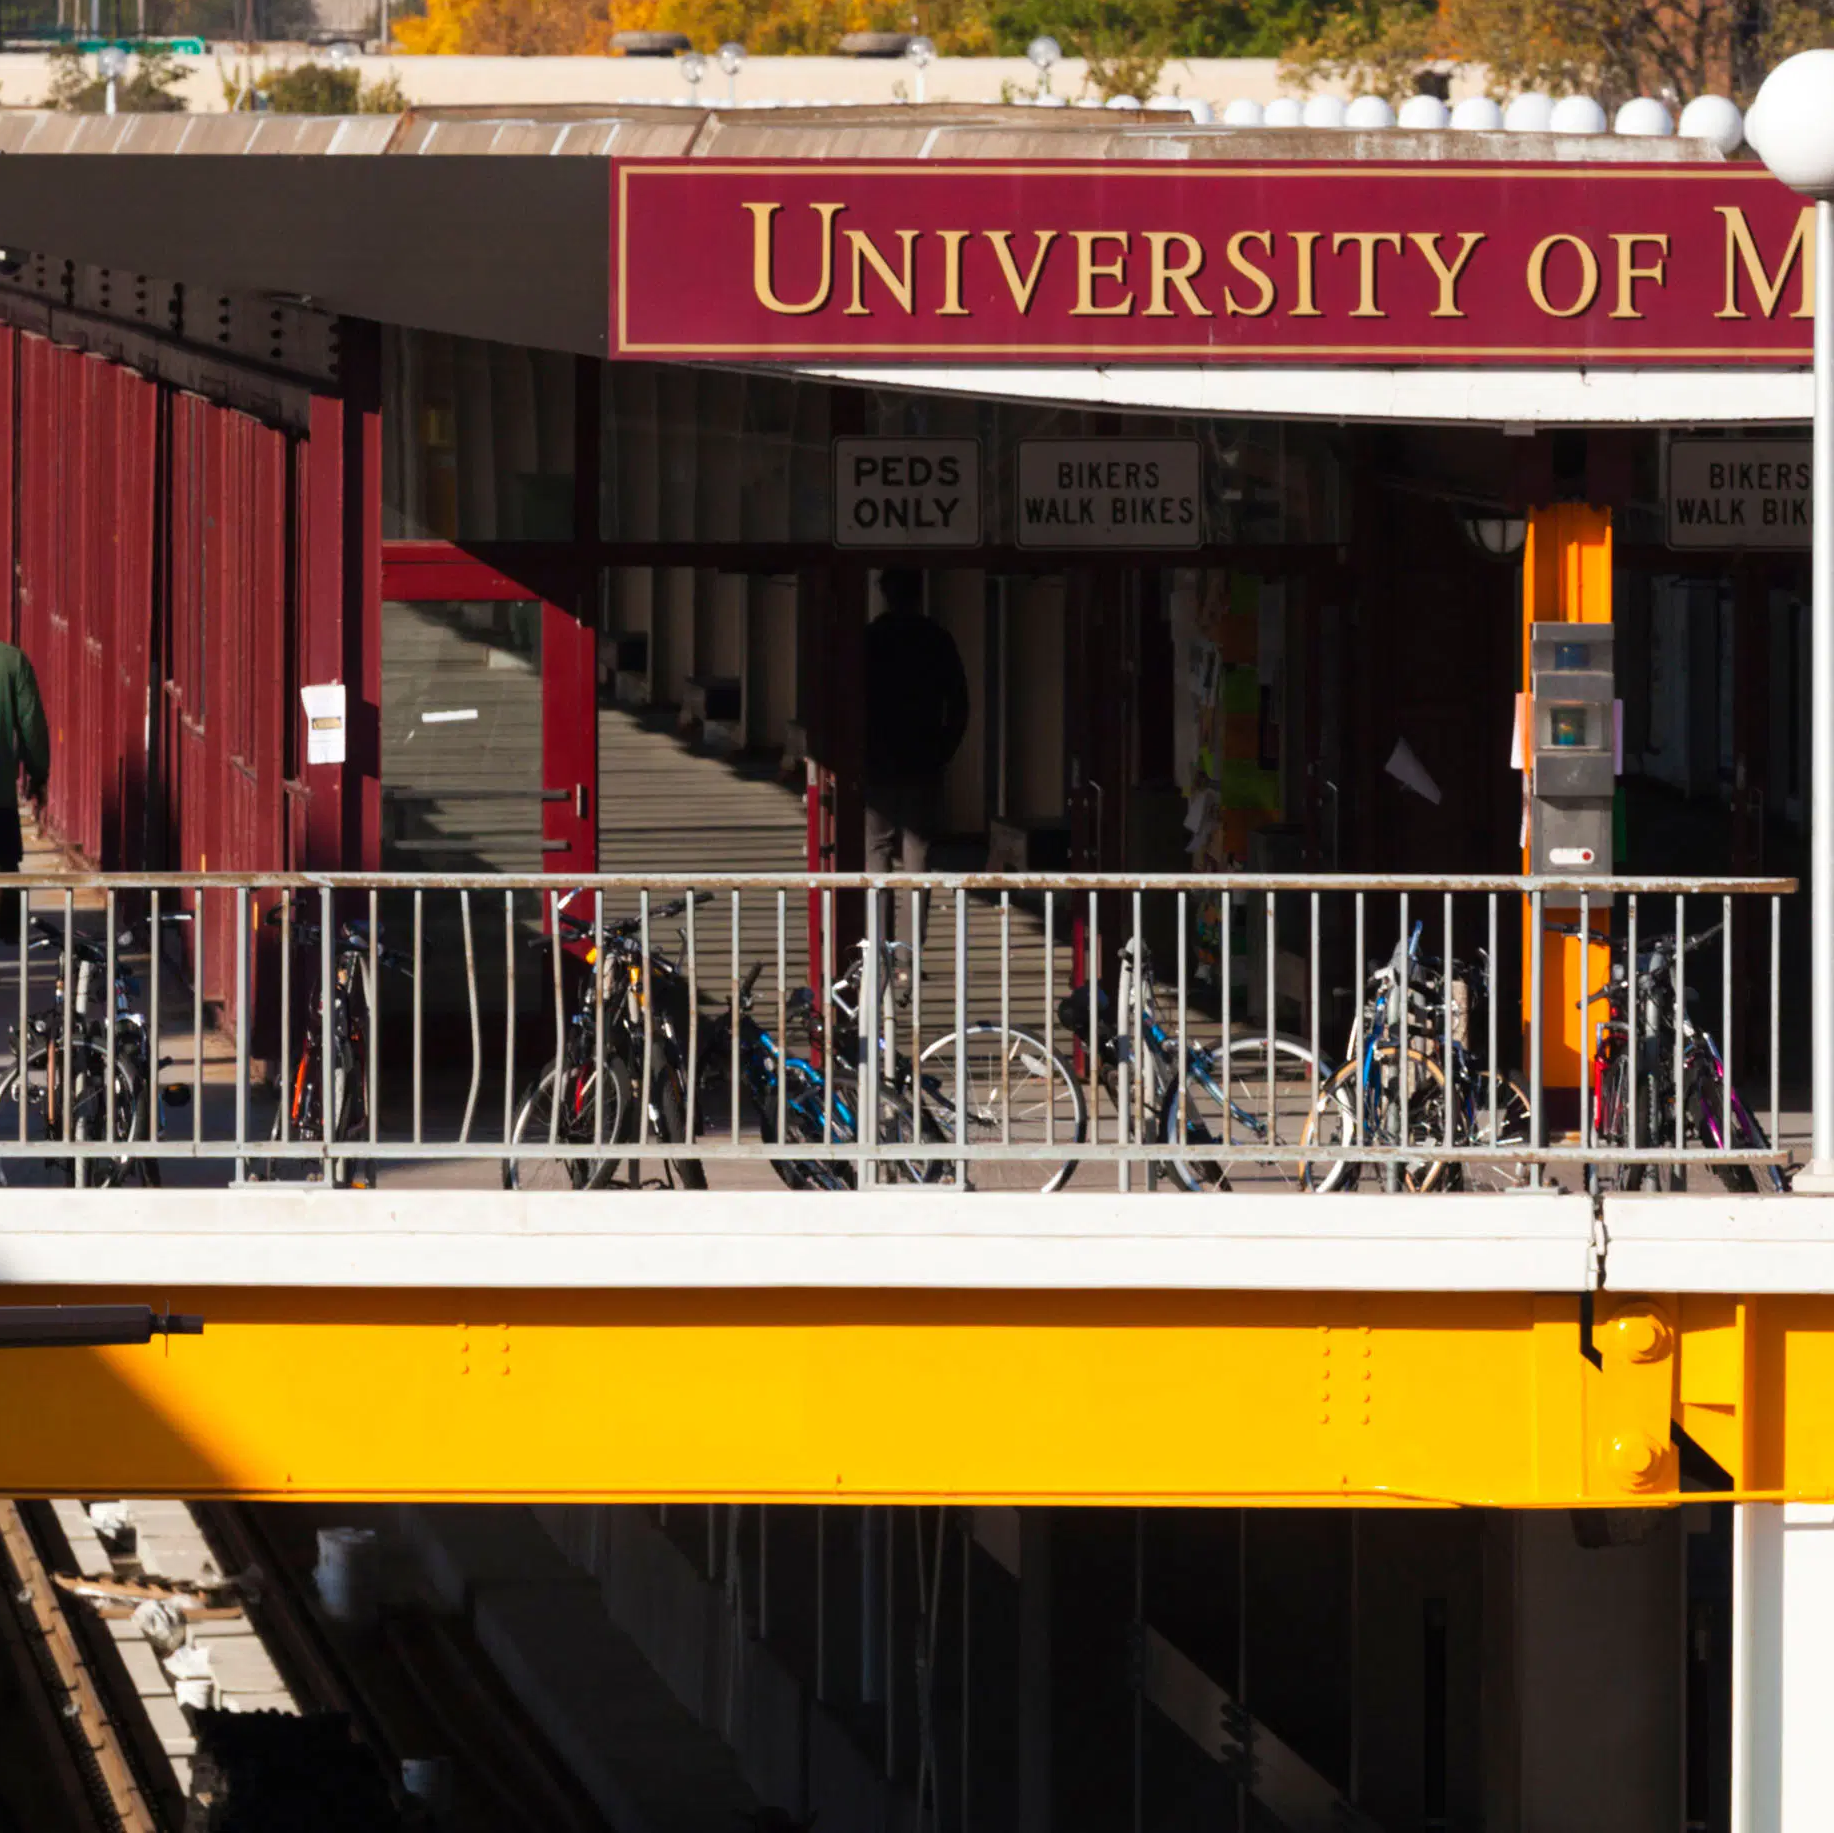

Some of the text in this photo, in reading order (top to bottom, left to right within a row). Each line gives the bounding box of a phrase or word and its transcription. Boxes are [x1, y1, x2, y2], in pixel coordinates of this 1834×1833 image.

[742, 201, 1485, 316] UNIVERSITY
[1526, 232, 1669, 318] OF
[854, 456, 960, 487] PEDS
[1058, 461, 1160, 490] BIKERS
[1709, 462, 1810, 491] BIKERS
[853, 497, 960, 531] ONLY
[1024, 496, 1194, 525] WALK BIKES
[1676, 497, 1809, 527] WALK BIK
